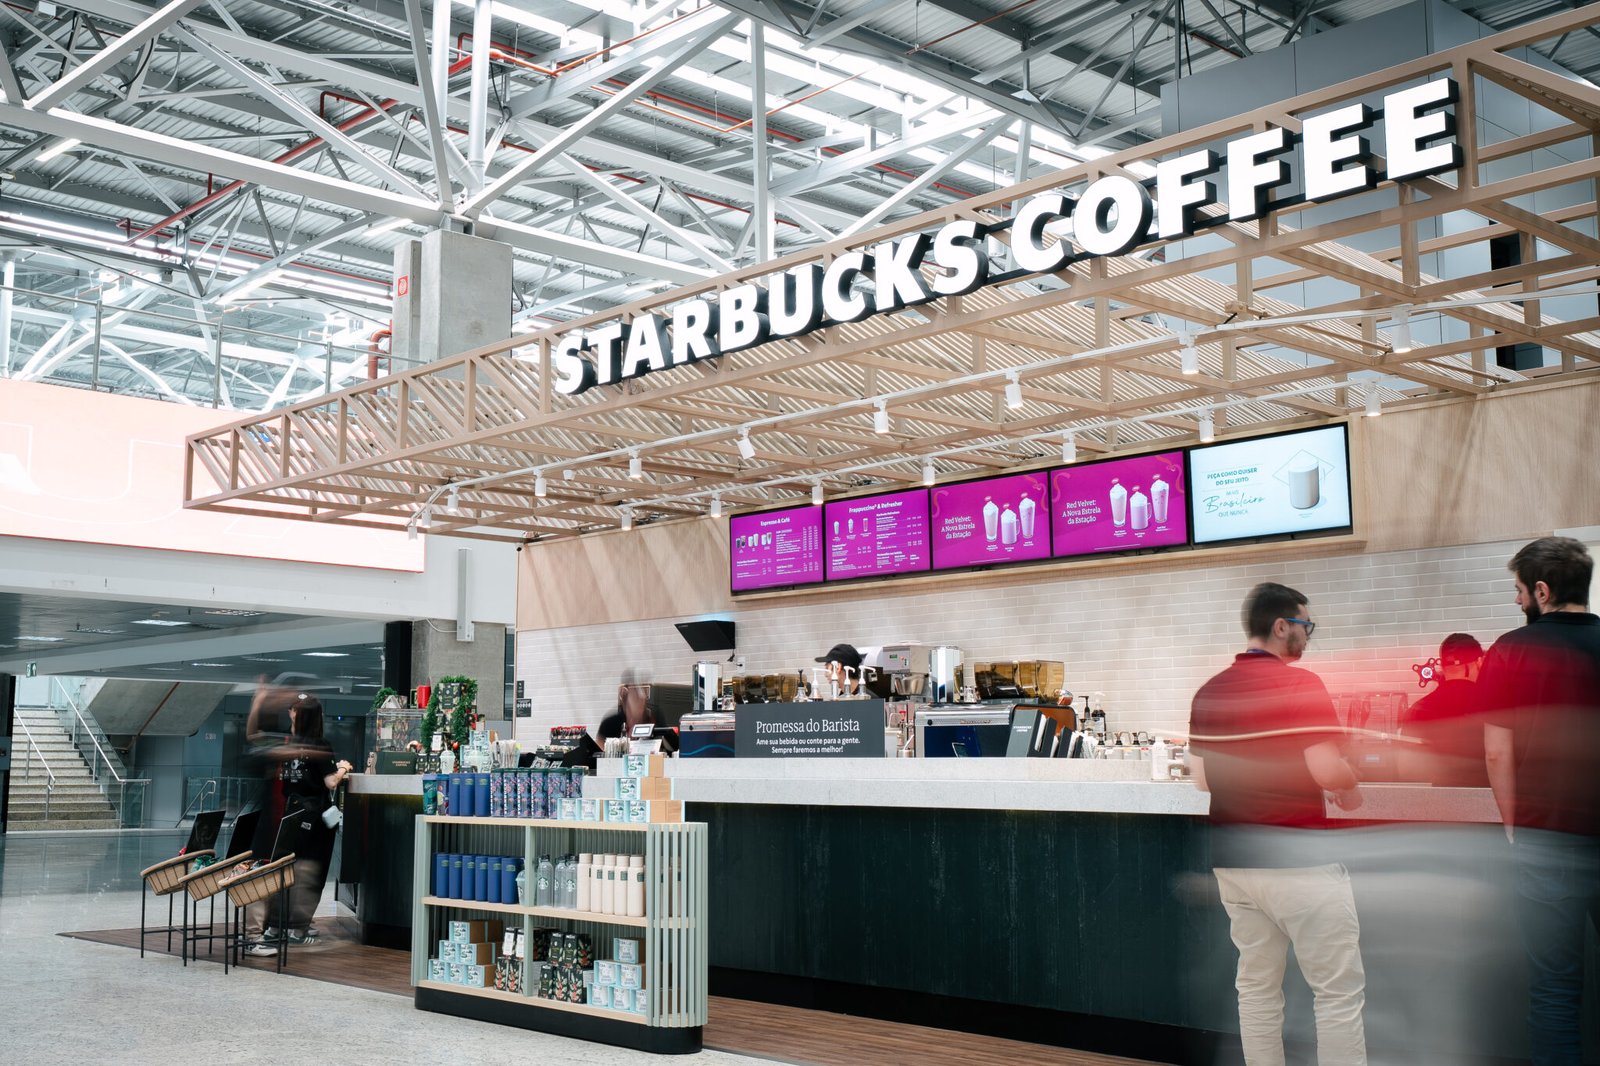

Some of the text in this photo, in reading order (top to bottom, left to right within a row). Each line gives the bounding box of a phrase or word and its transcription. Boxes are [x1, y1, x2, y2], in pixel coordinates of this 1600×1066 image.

[555, 77, 1455, 395] STARBUCKS COFFEE
[1221, 470, 1238, 478] COMO
[1238, 467, 1258, 475] QUISER
[1235, 476, 1249, 484] JEITO
[1066, 499, 1097, 509] Red Velvet:
[1202, 492, 1265, 514] Brasileiro
[1067, 508, 1081, 517] Nova
[1081, 506, 1101, 515] Estrela
[944, 517, 955, 525] Red
[1067, 515, 1097, 525] da Estação
[946, 525, 958, 533] Nova
[958, 522, 976, 531] Estrela
[945, 530, 972, 540] da Estação
[756, 717, 861, 734] Promessa do Barista
[823, 738, 837, 746] para
[841, 737, 861, 746] gente.
[771, 746, 793, 754] Sempre
[793, 745, 816, 754] faremos
[820, 745, 844, 753] melhor!
